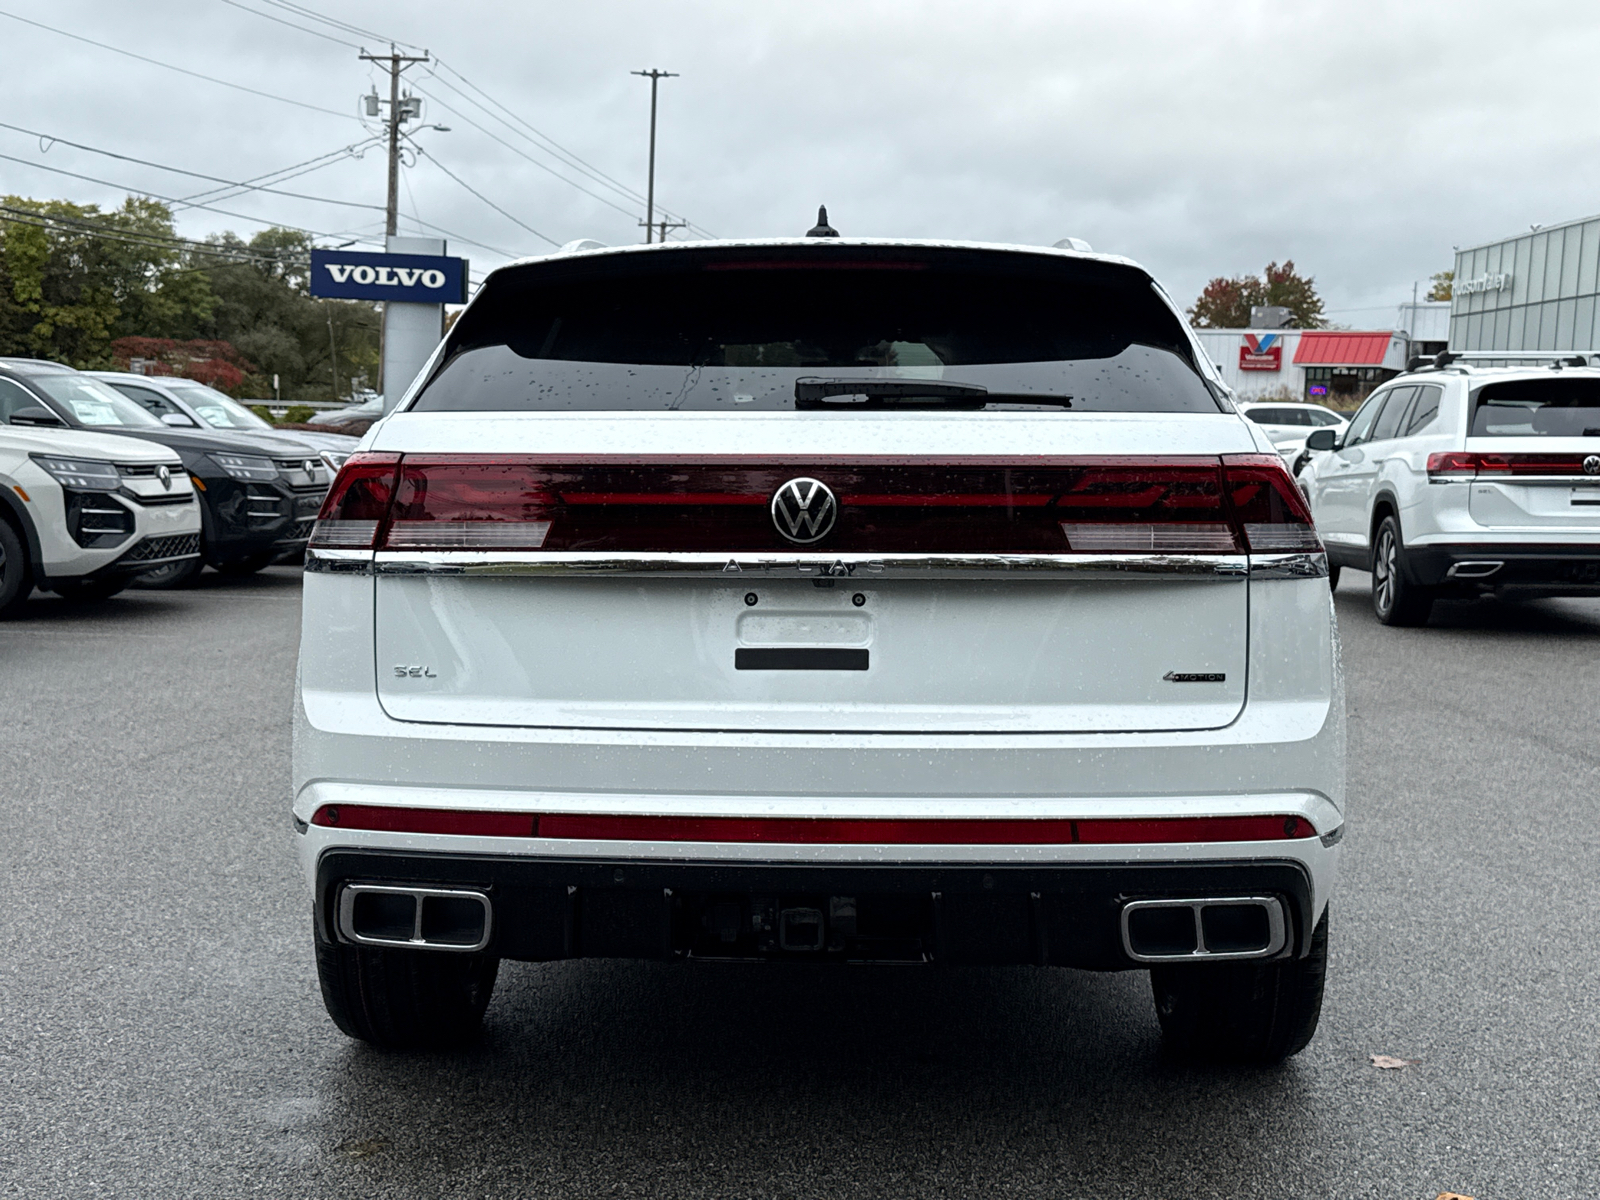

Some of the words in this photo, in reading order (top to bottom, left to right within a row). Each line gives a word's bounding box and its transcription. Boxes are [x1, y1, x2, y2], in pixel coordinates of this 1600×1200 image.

[324, 263, 446, 289] VOLVO
[722, 558, 886, 574] ATLAS
[394, 665, 437, 678] SEL
[1163, 670, 1225, 682] 4MOTION
